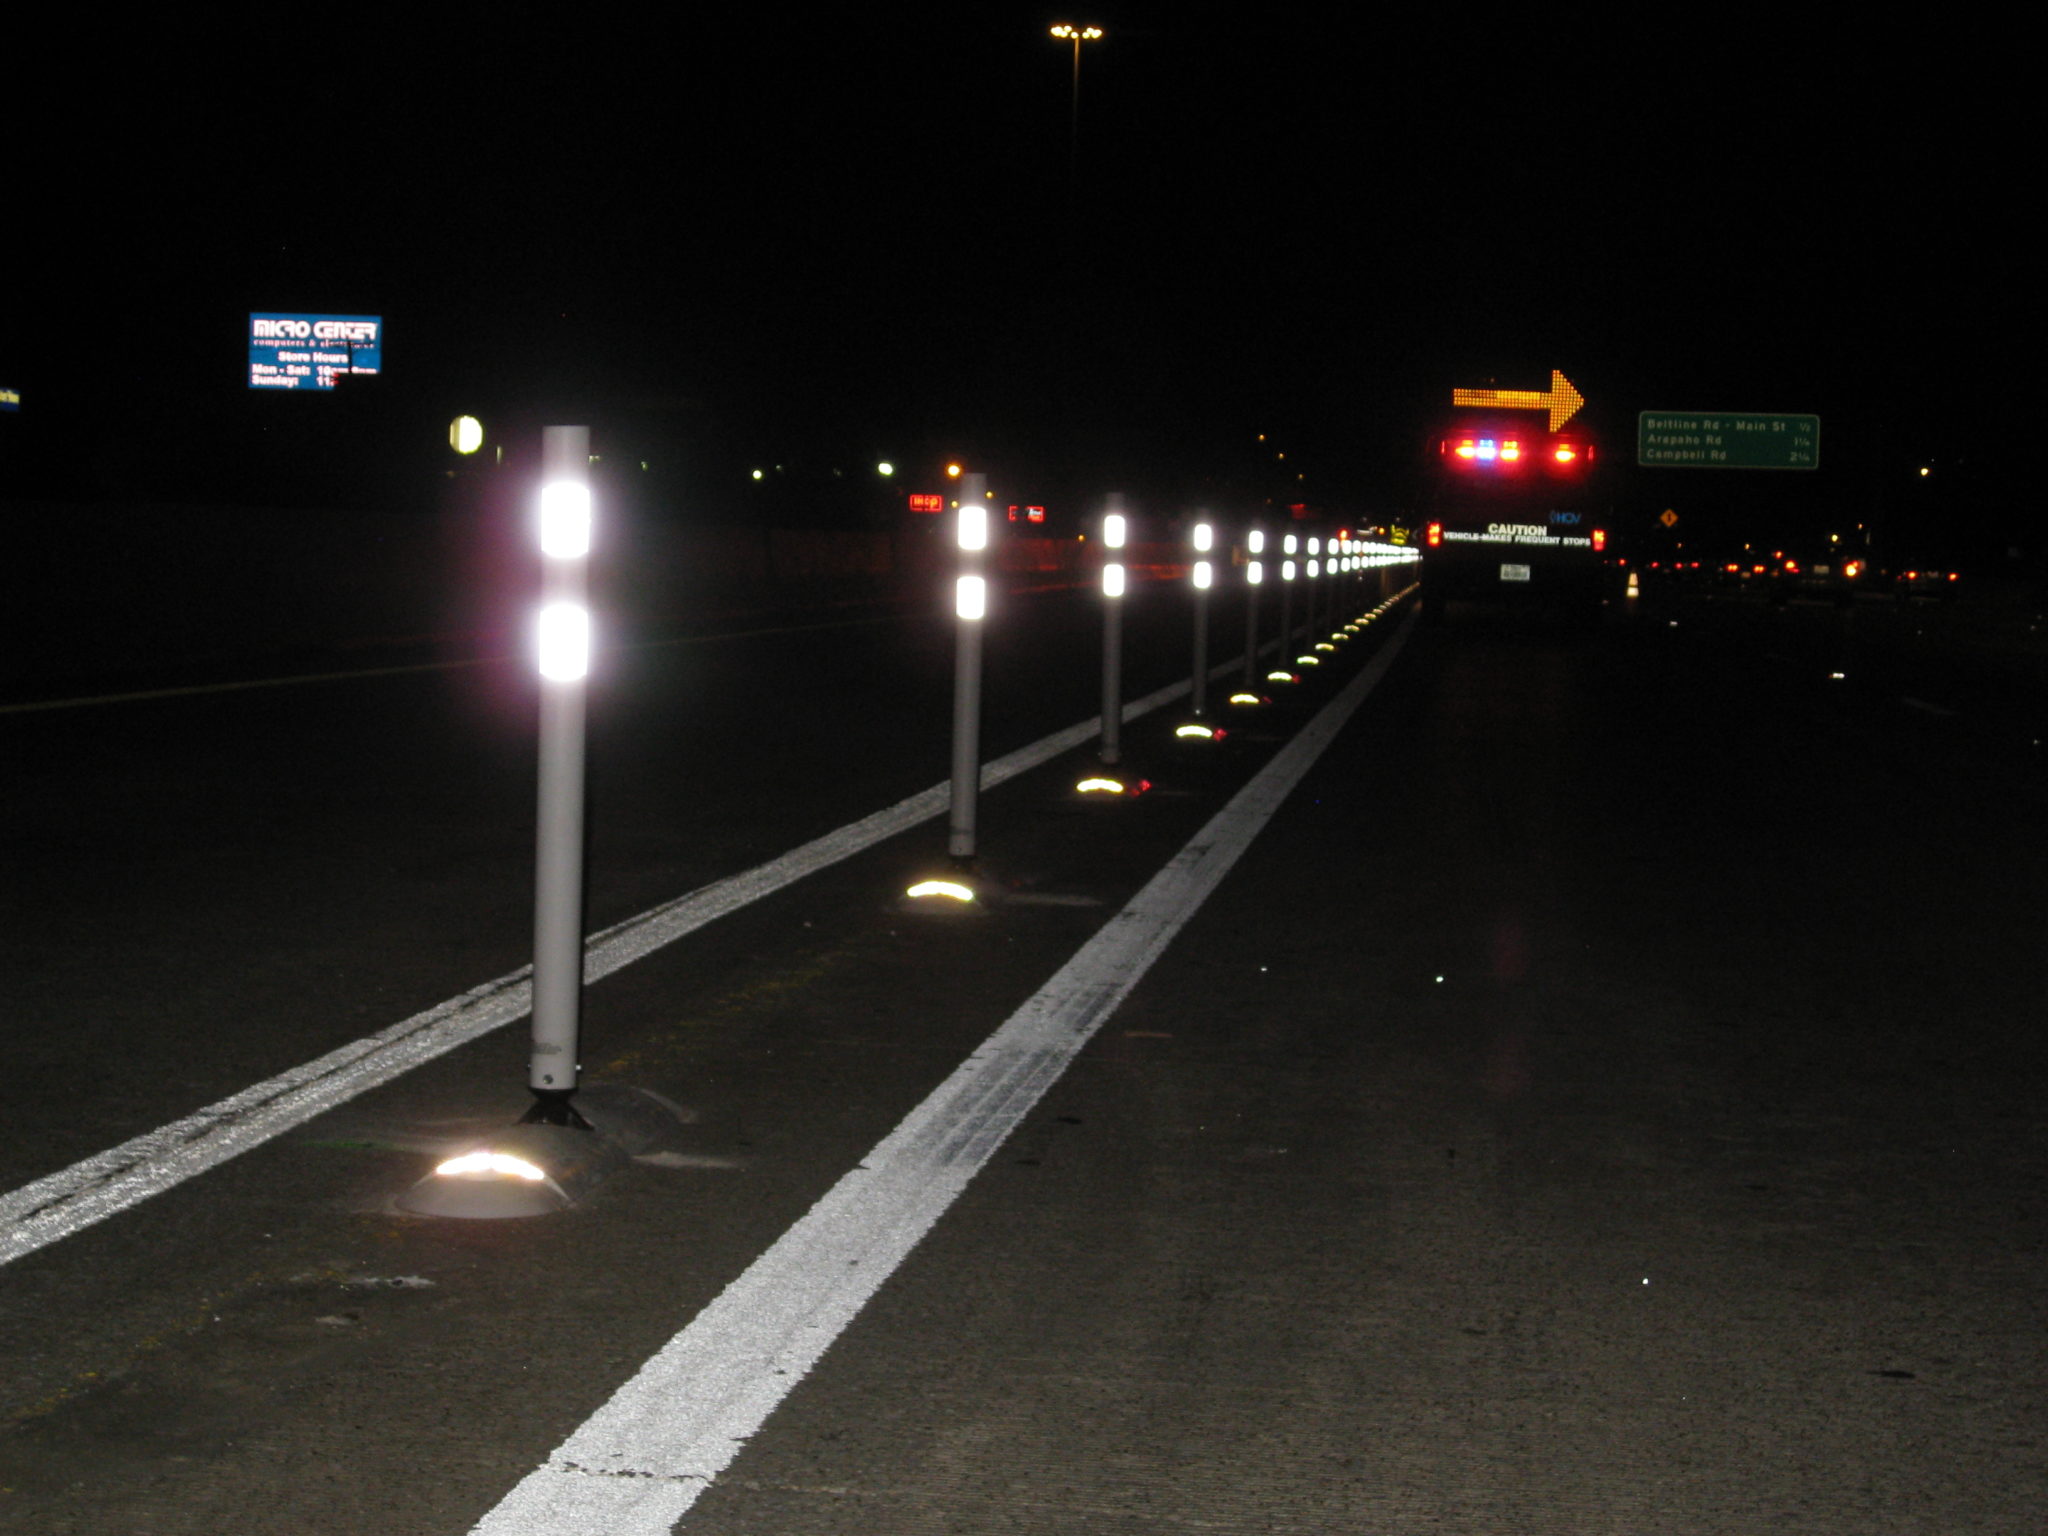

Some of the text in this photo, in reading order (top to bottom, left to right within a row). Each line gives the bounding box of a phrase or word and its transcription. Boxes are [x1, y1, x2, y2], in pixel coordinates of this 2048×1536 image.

[253, 319, 377, 340] MICRO CENTER
[253, 339, 305, 349] computers
[278, 351, 349, 363] Store Hours
[252, 364, 278, 375] Mon
[252, 375, 299, 388] Sunday:
[1647, 419, 1697, 430] Beltline
[1703, 420, 1719, 431] Rd
[1736, 421, 1766, 431] Main
[1772, 422, 1786, 432] St
[1647, 434, 1700, 445] Arapaho
[1706, 435, 1722, 445] Rd
[1646, 449, 1705, 460] Campbell
[1711, 450, 1727, 461] Rd
[1488, 523, 1547, 535] CAUTION
[1514, 535, 1561, 545] FREQUENT
[1563, 537, 1591, 547] STOPS
